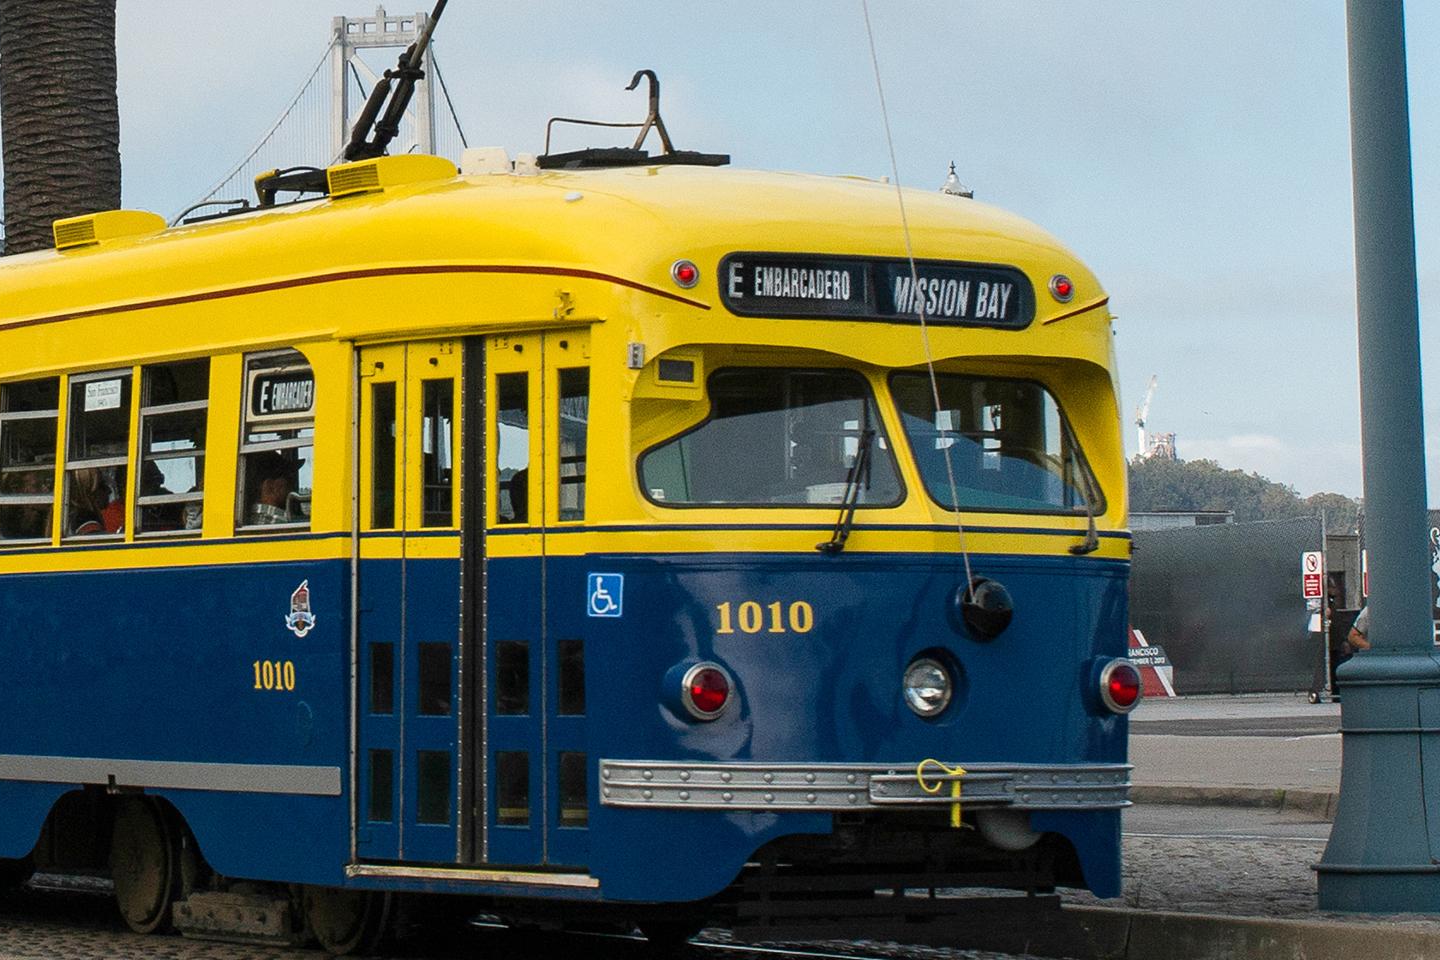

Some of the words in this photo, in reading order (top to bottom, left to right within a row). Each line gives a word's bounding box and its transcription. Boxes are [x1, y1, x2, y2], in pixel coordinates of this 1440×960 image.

[728, 262, 744, 299] E
[754, 266, 851, 301] EMBARCADERO
[894, 276, 970, 317] MISSION
[975, 281, 1013, 319] BAY
[260, 381, 270, 413] E
[716, 601, 813, 633] 1010
[253, 660, 295, 690] 1010
